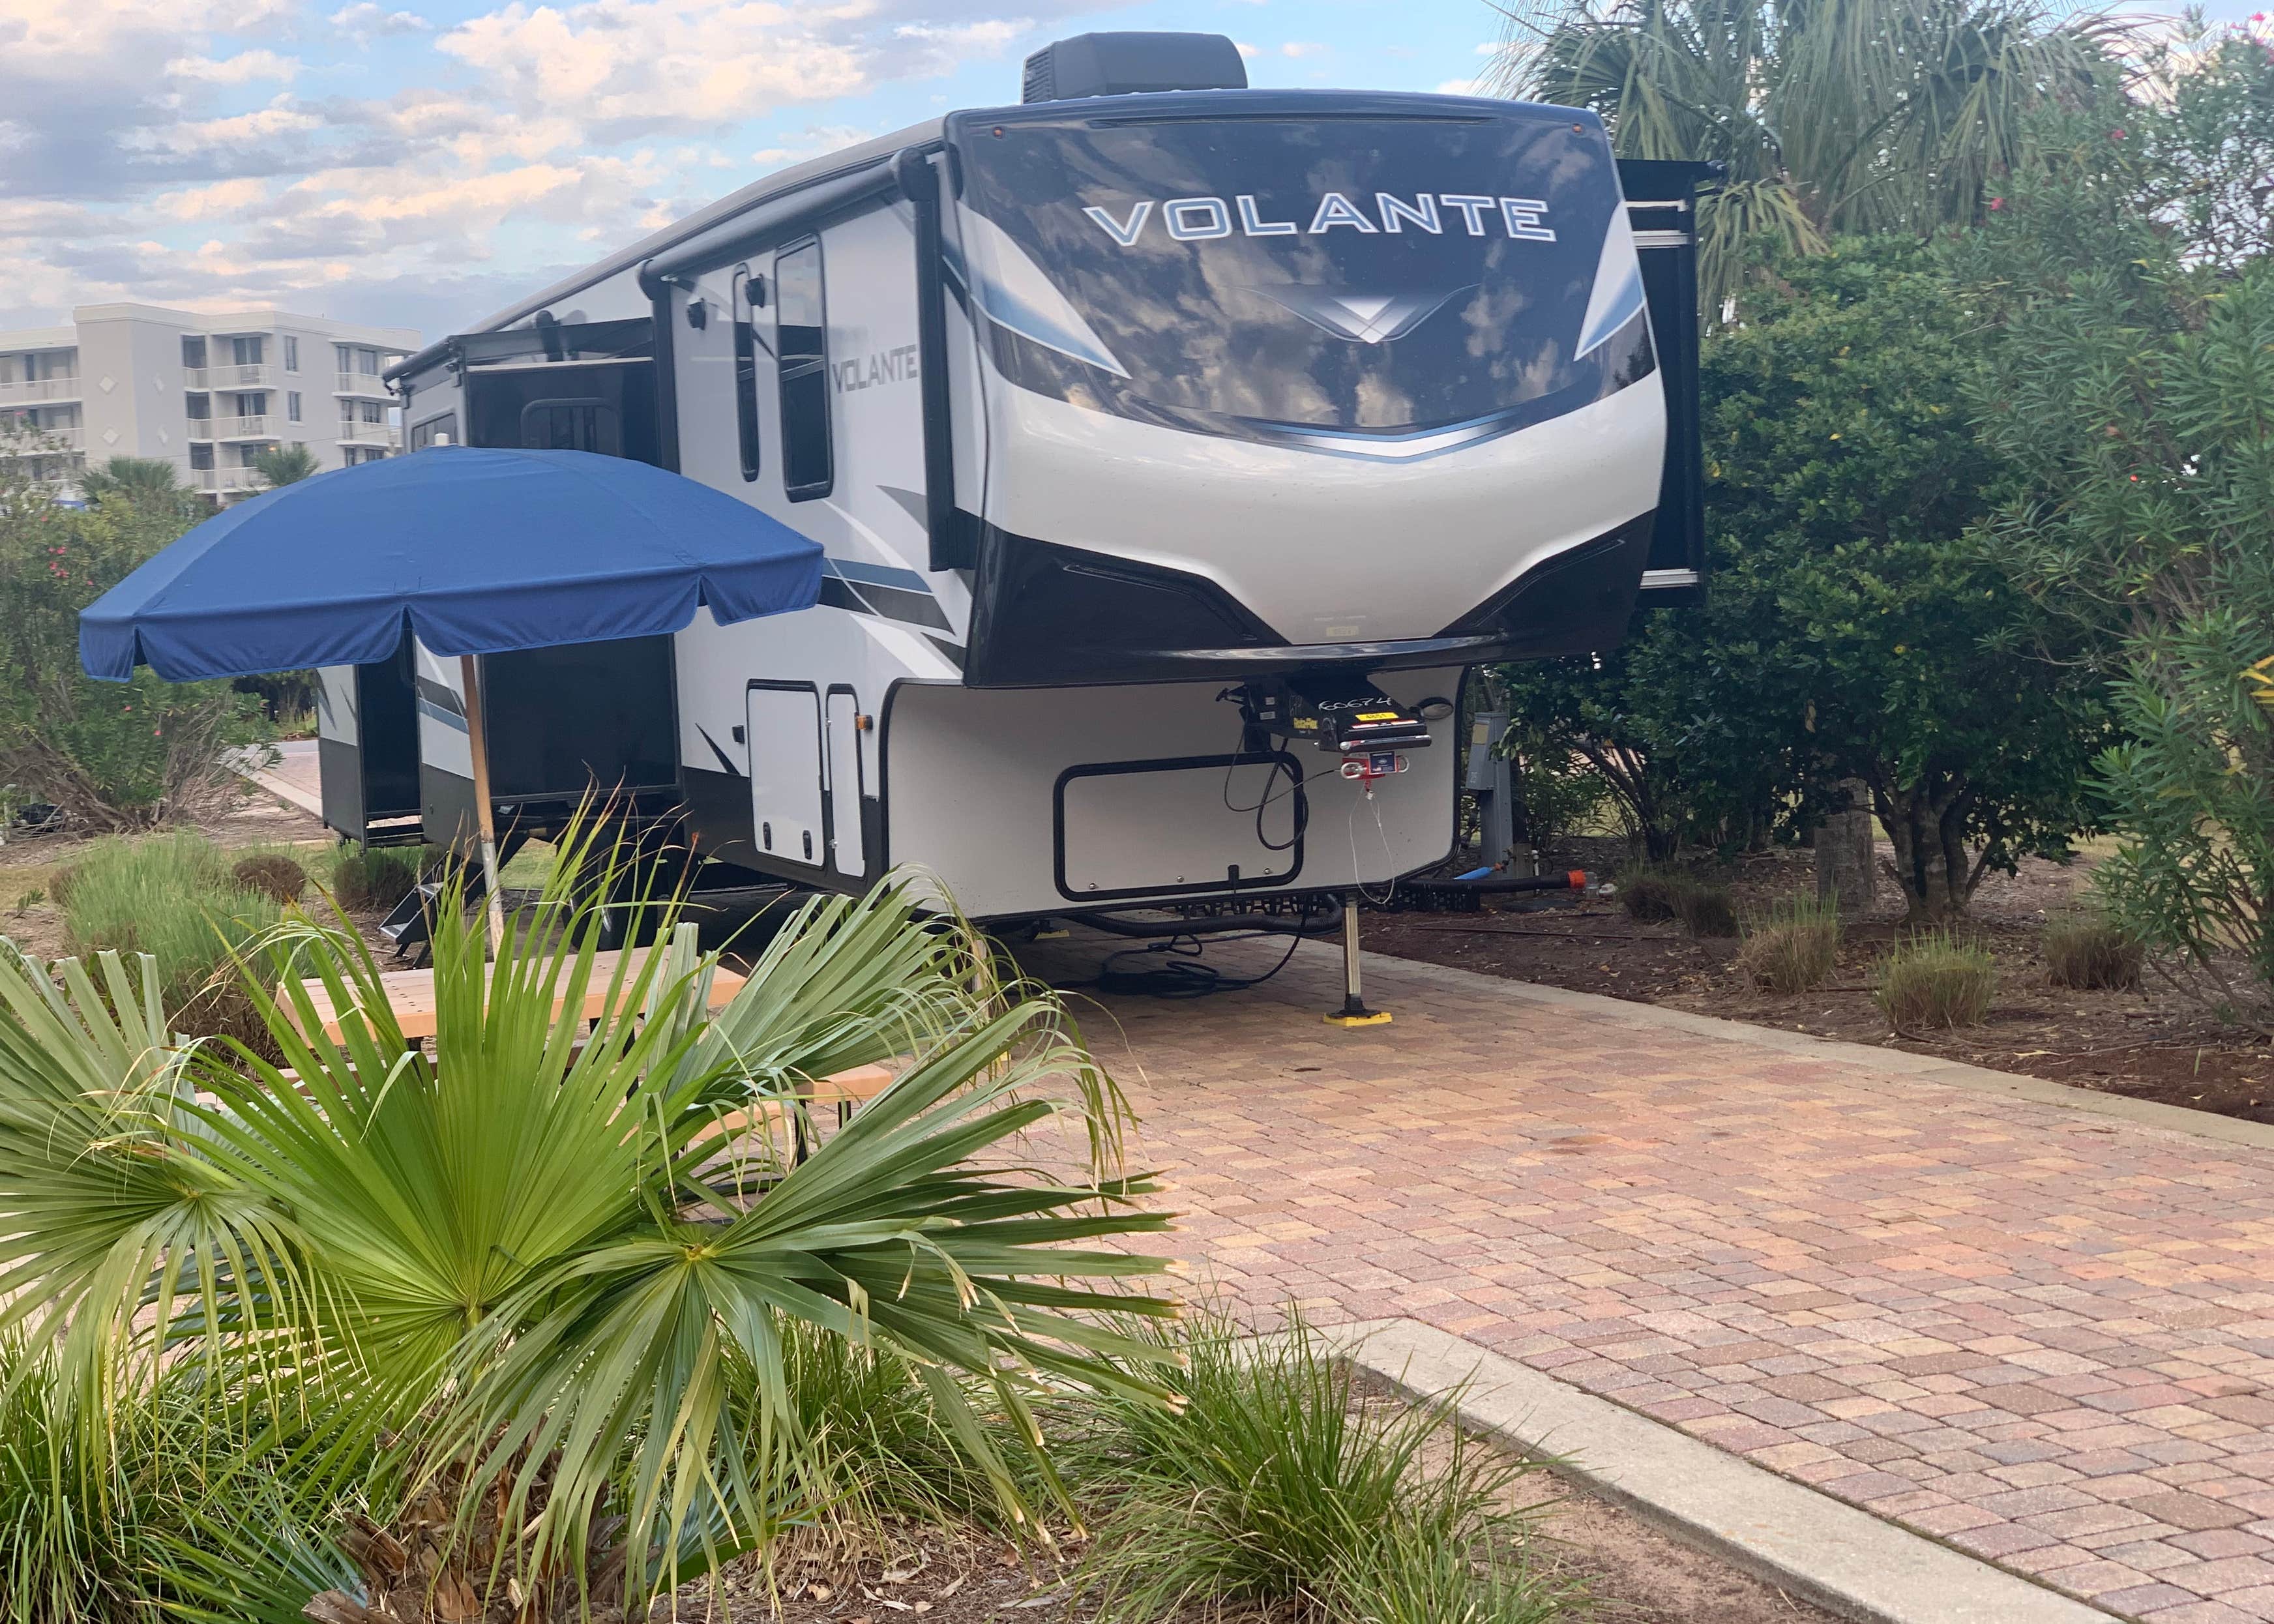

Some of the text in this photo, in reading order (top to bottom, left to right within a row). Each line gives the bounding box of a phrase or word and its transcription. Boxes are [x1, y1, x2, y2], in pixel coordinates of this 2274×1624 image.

[1083, 192, 1556, 246] VOLANTE
[832, 344, 918, 394] VOLANTE
[1318, 697, 1392, 711] 60674
